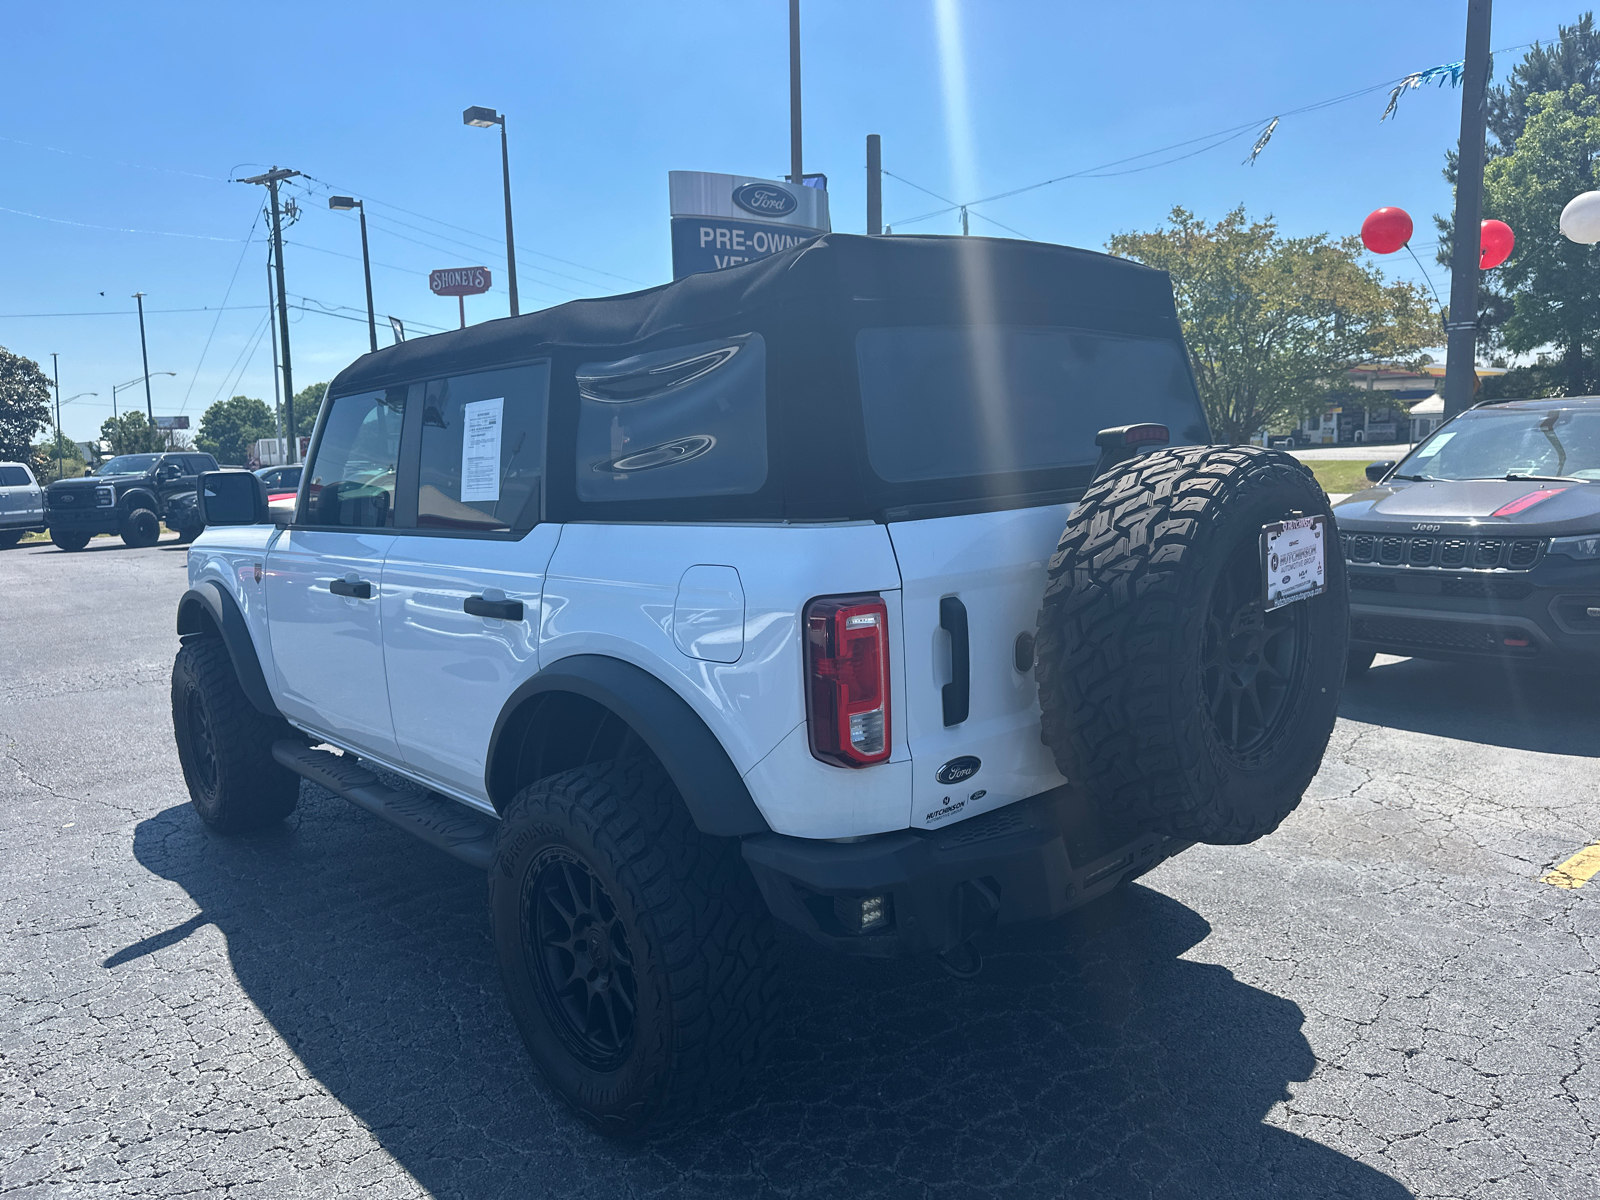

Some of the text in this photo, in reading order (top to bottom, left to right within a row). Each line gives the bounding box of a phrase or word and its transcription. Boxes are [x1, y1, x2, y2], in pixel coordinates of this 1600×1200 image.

[751, 190, 785, 210] Ford
[700, 227, 808, 253] PRE-OWN
[432, 269, 485, 291] SHONEY'S
[1412, 523, 1441, 533] Jeep
[948, 765, 973, 780] Ford
[926, 801, 965, 821] HUTCHINSON
[505, 822, 567, 870] PREDATOR
